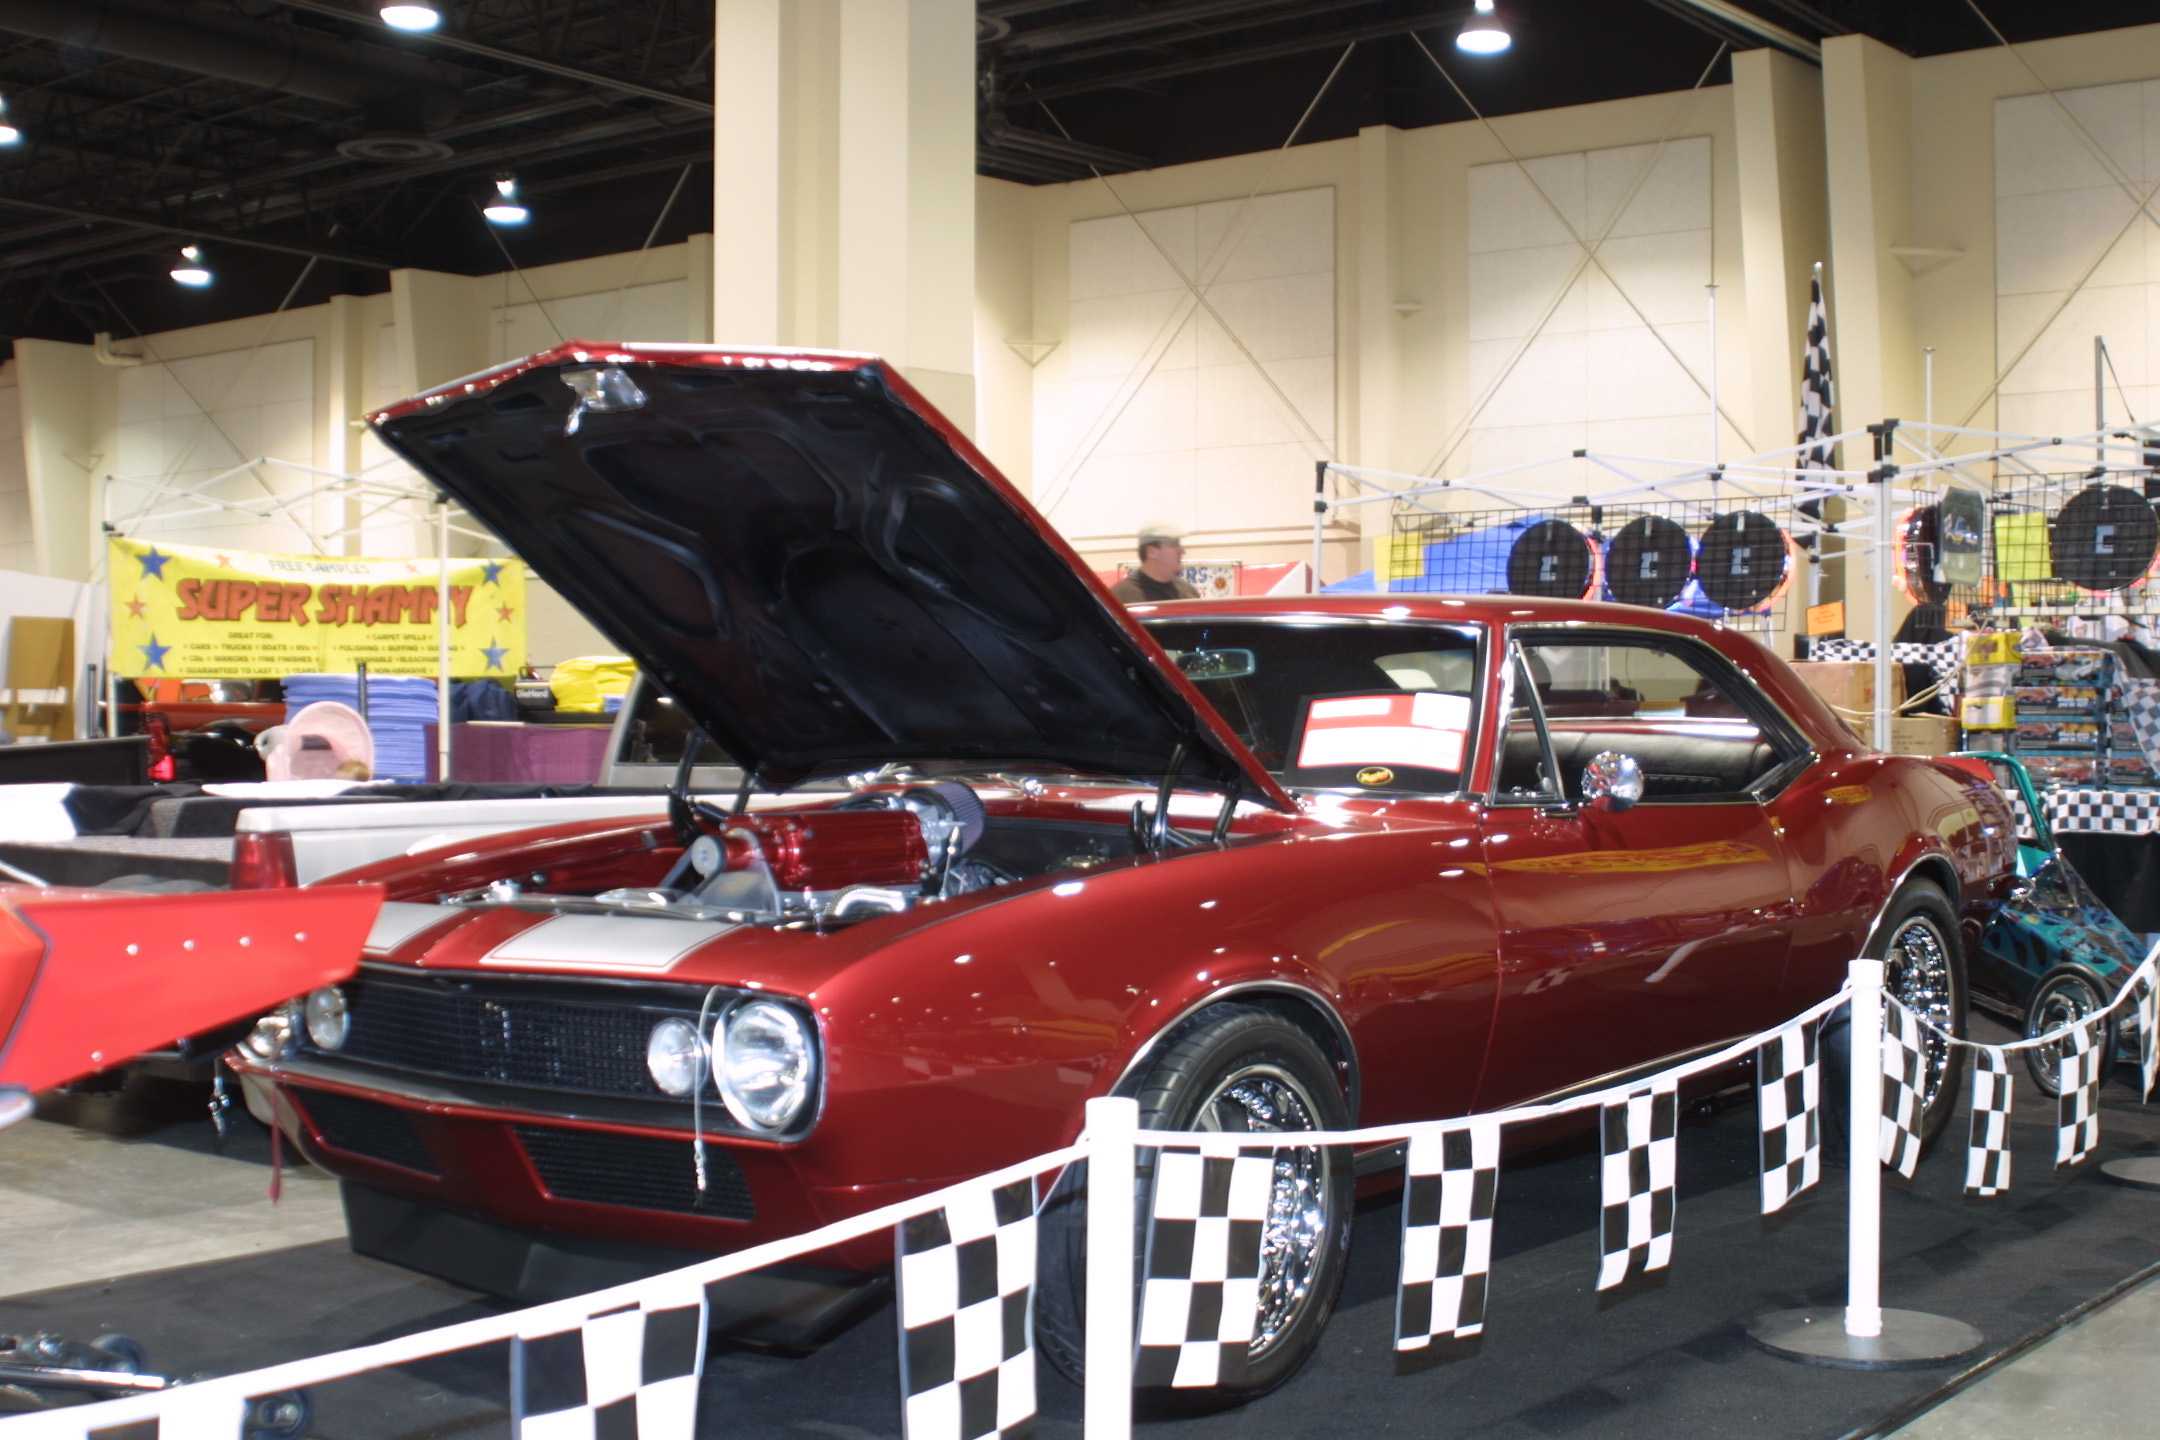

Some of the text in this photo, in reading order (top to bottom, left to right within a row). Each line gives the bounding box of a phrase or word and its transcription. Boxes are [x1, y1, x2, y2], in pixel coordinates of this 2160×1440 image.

[176, 578, 475, 629] SUPER SHAMMY
[228, 631, 253, 639] GREAT
[190, 643, 211, 651] CARS
[221, 643, 252, 651] TRUCKS
